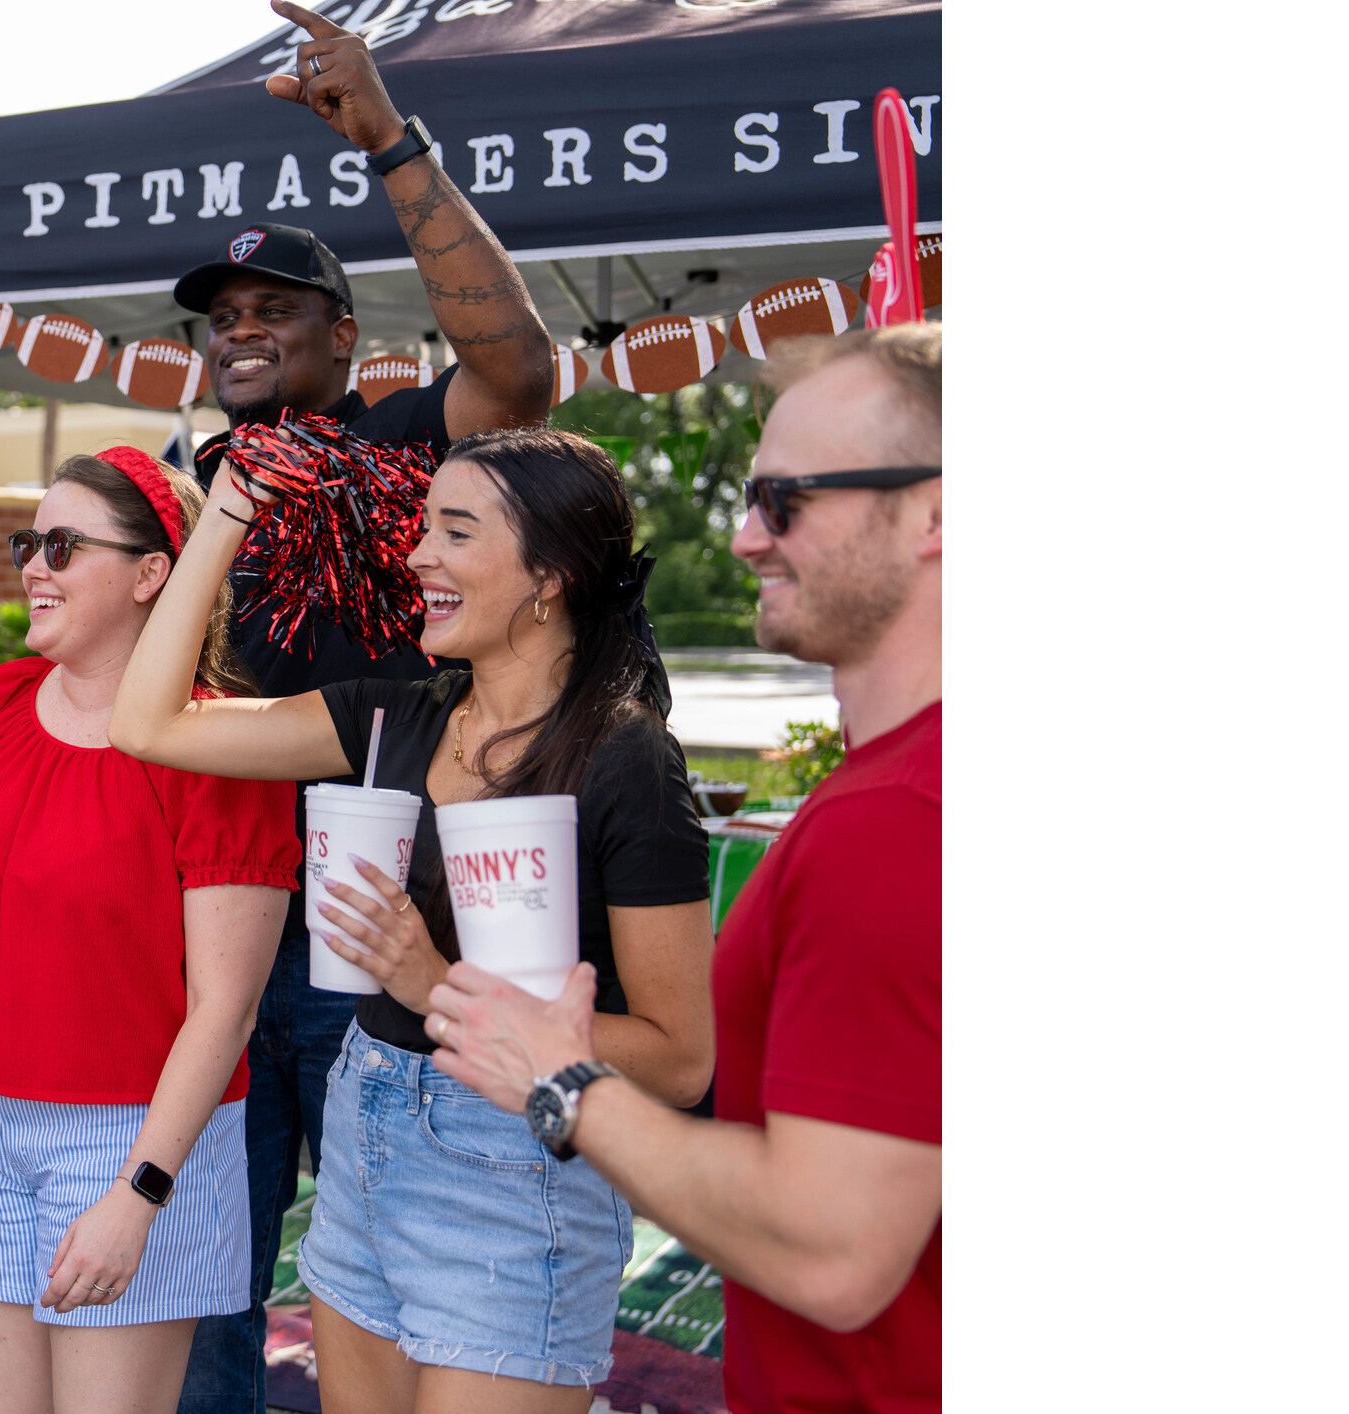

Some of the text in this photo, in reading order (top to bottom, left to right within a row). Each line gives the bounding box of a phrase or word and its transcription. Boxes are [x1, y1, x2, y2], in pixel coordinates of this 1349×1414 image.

[23, 122, 668, 238] PITMASERS
[306, 828, 329, 858] Y'S
[446, 847, 547, 887] SONNY'S
[454, 884, 495, 910] BBQ
